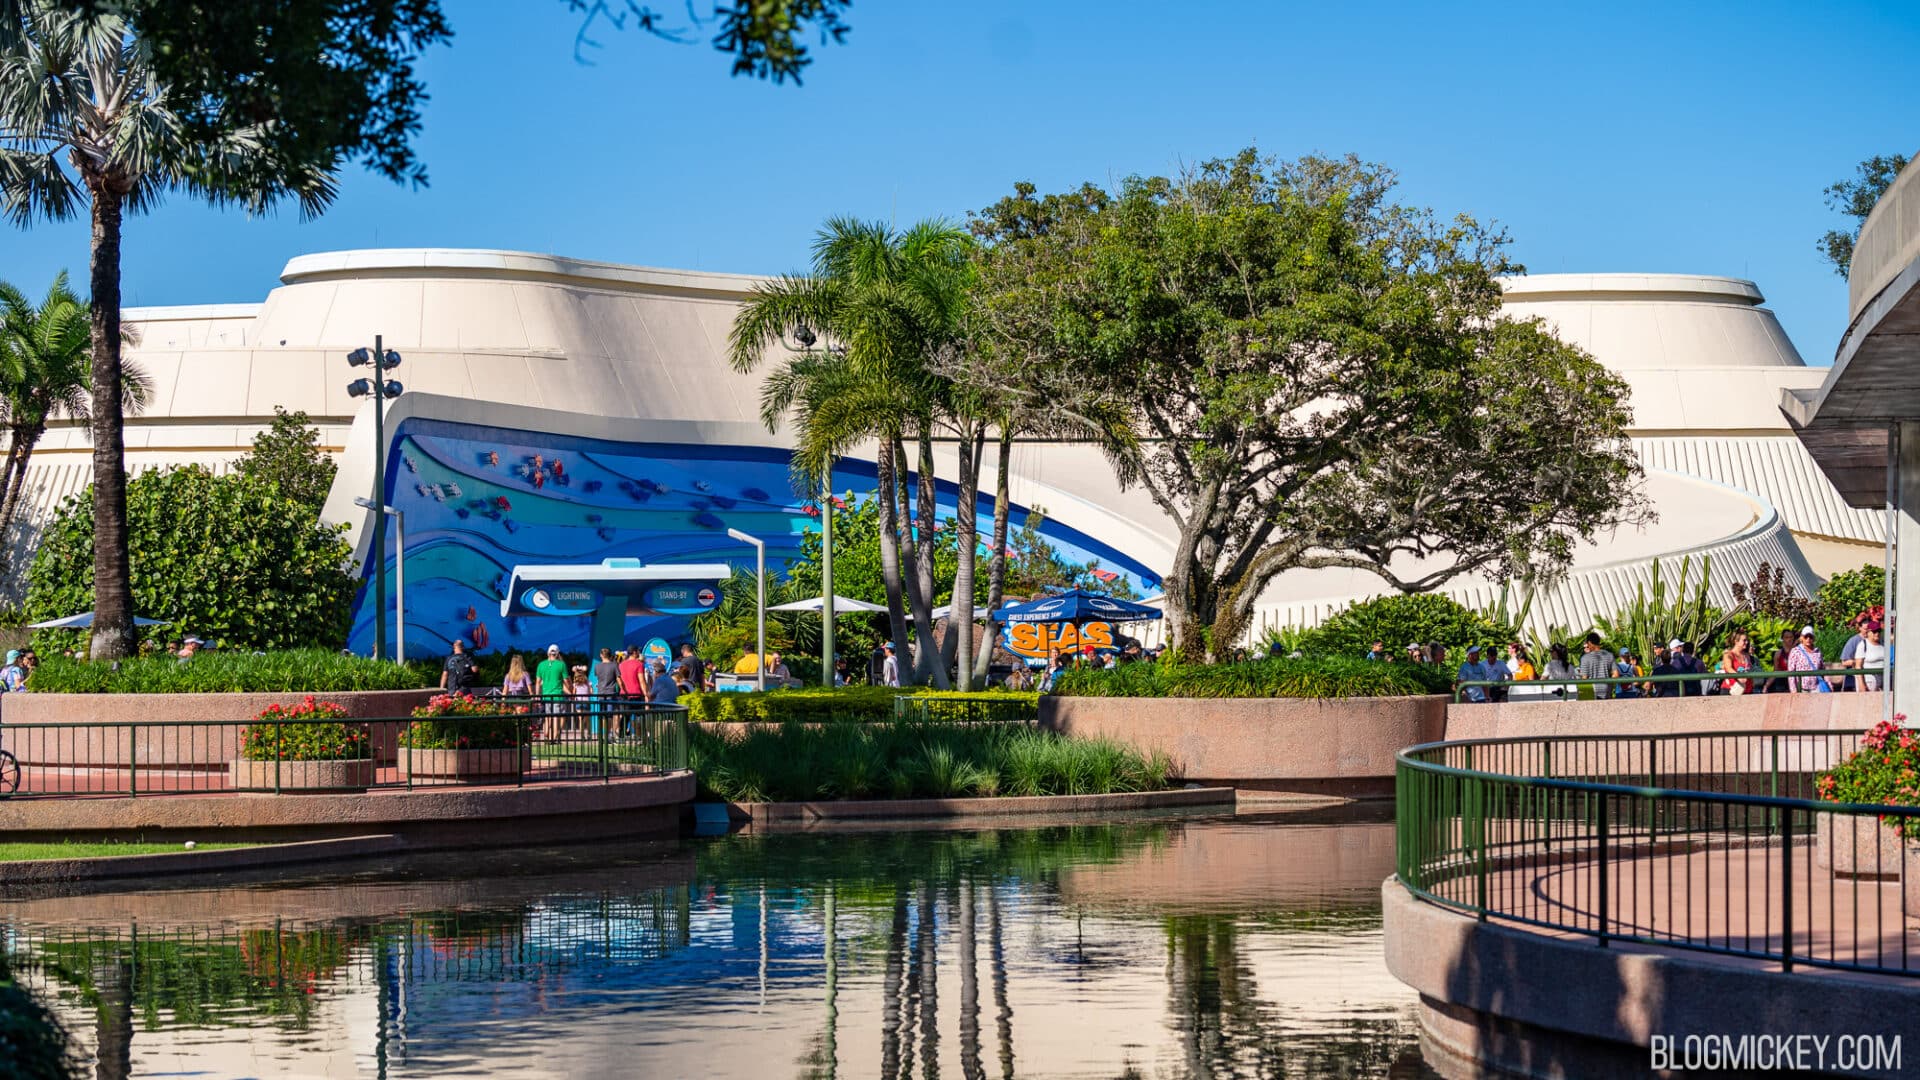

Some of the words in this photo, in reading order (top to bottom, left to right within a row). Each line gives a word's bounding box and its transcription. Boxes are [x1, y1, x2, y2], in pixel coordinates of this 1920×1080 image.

[557, 591, 591, 600] LIGHTNING
[659, 591, 687, 600] STAND-BY
[1011, 621, 1113, 651] SEAS
